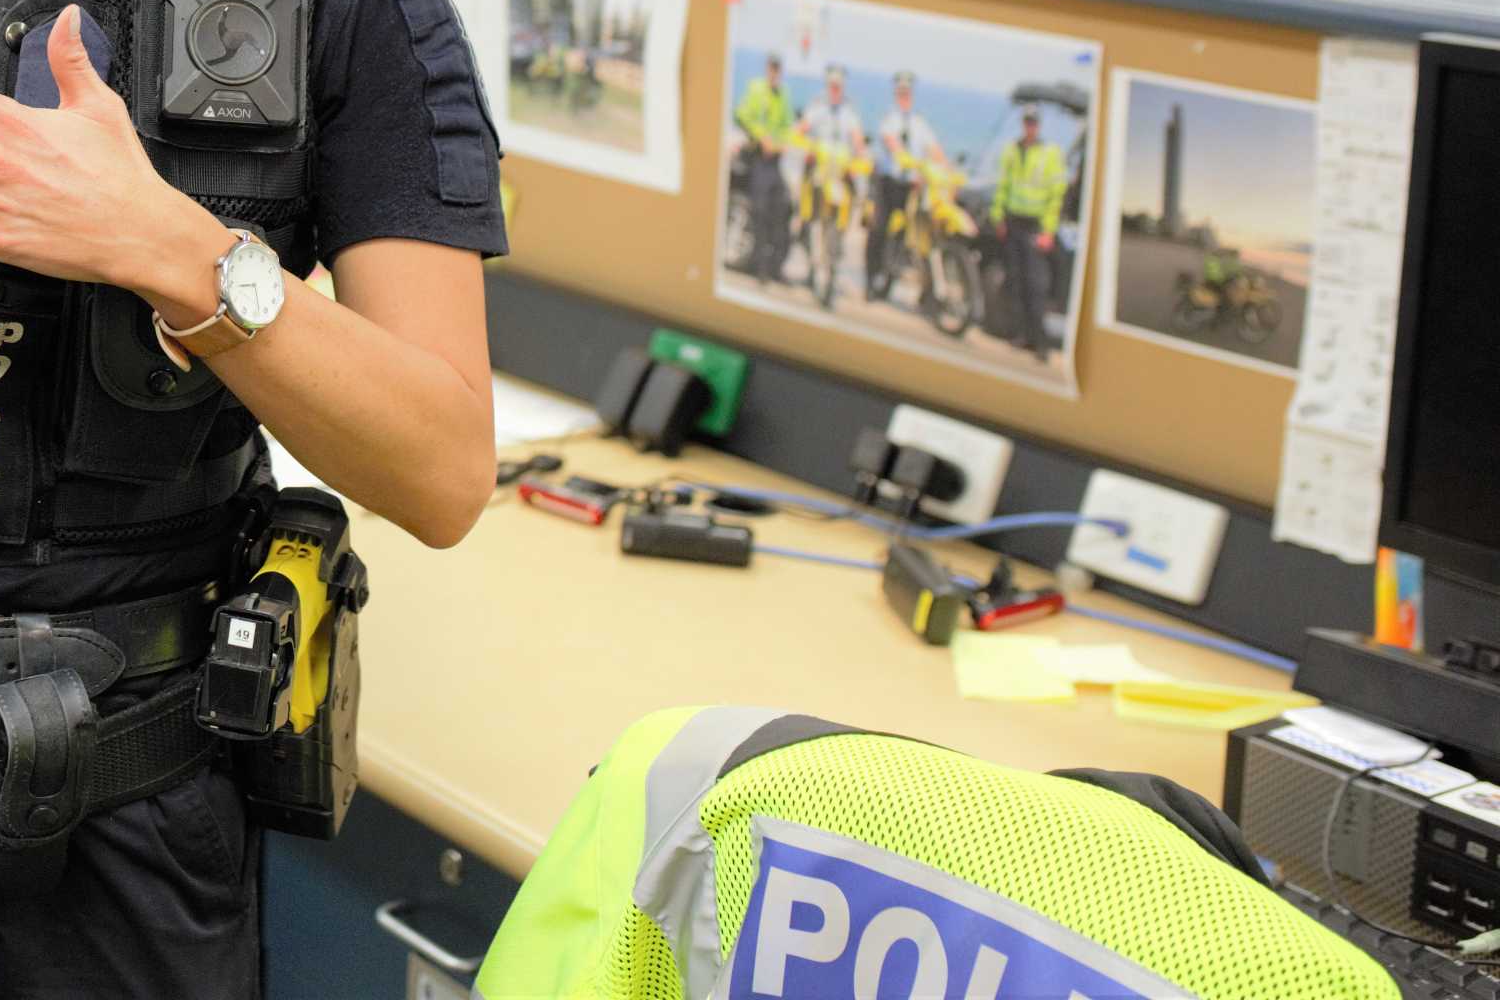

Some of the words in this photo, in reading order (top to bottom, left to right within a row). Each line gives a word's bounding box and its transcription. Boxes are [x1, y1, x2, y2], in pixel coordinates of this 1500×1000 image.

[217, 107, 252, 119] AXON
[235, 629, 250, 641] 49
[751, 865, 1097, 1000] PO
